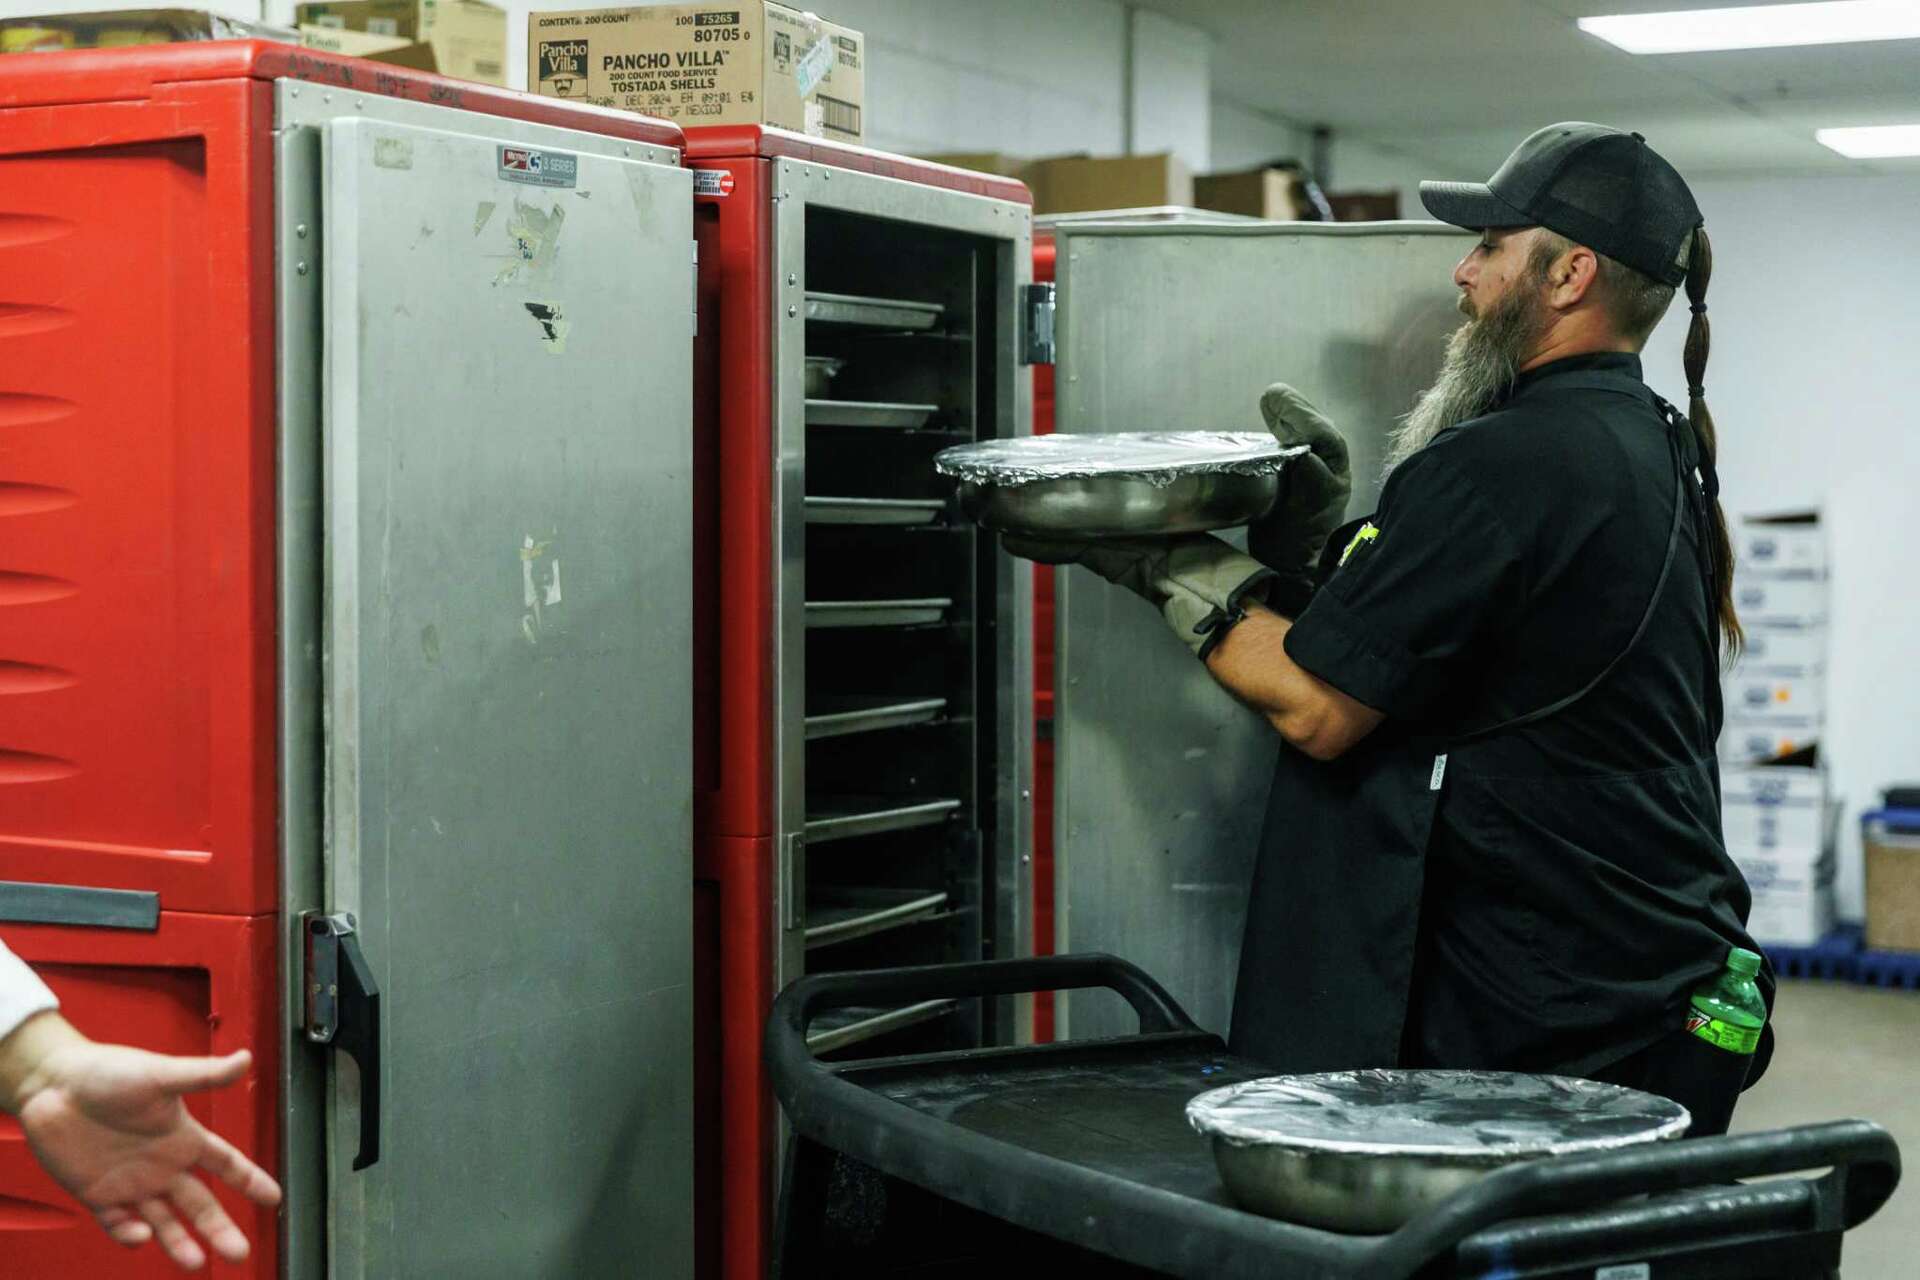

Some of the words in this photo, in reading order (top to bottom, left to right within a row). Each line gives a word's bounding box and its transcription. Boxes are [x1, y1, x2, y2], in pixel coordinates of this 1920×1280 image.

[585, 15, 600, 25] 200
[602, 14, 631, 24] COUNT
[675, 15, 694, 26] 100
[702, 13, 734, 24] 75265
[694, 28, 740, 43] 80705
[540, 41, 587, 58] Pancho
[548, 55, 578, 73] Villa
[603, 52, 671, 72] PANCHO
[609, 72, 625, 82] 200
[627, 71, 655, 81] COUNT
[657, 70, 680, 79] FOOD
[682, 68, 719, 78] SERVICE
[611, 80, 666, 94] TOSTADA
[670, 78, 716, 91] SHELLS
